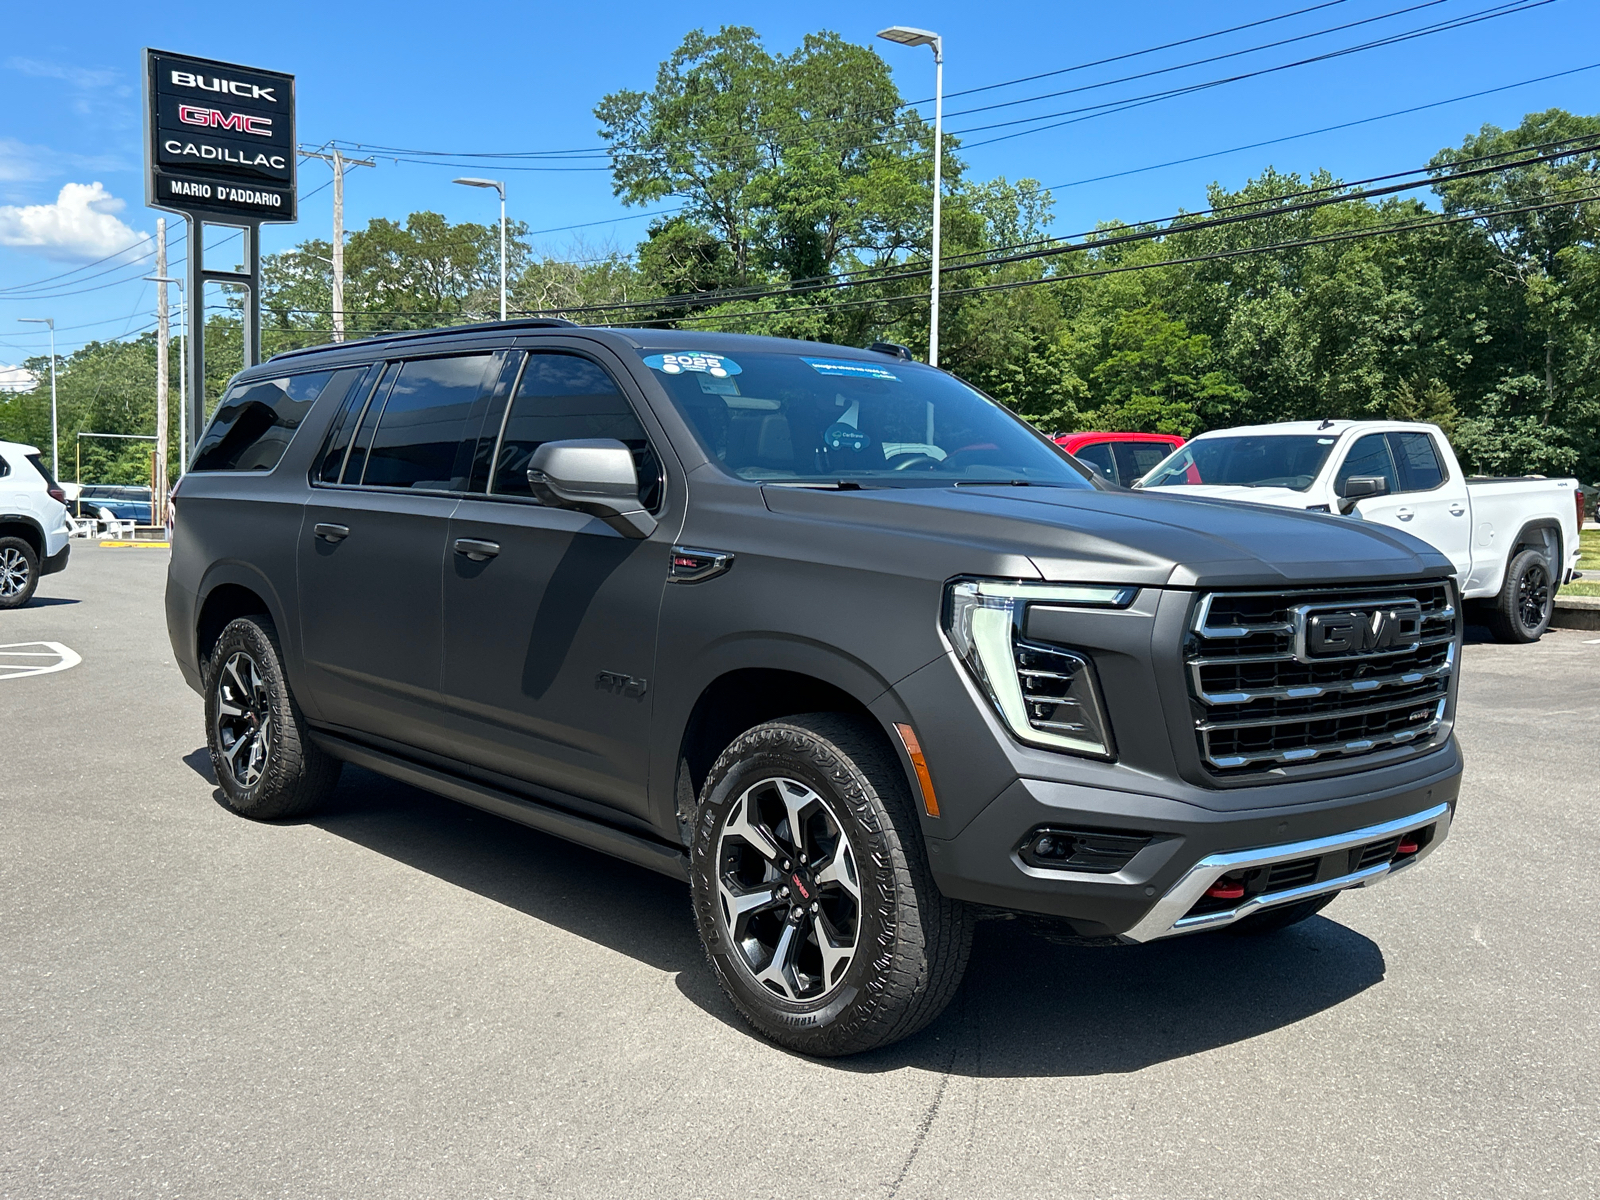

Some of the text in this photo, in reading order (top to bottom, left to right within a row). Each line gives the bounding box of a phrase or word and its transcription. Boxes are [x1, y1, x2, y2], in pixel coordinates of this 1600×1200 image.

[171, 70, 278, 102] BUICK
[178, 103, 273, 137] GMC
[165, 140, 286, 169] CADILLAC
[171, 180, 282, 207] MARIO D'ADDARIO
[663, 354, 721, 368] 2025
[1310, 611, 1420, 652] GMC
